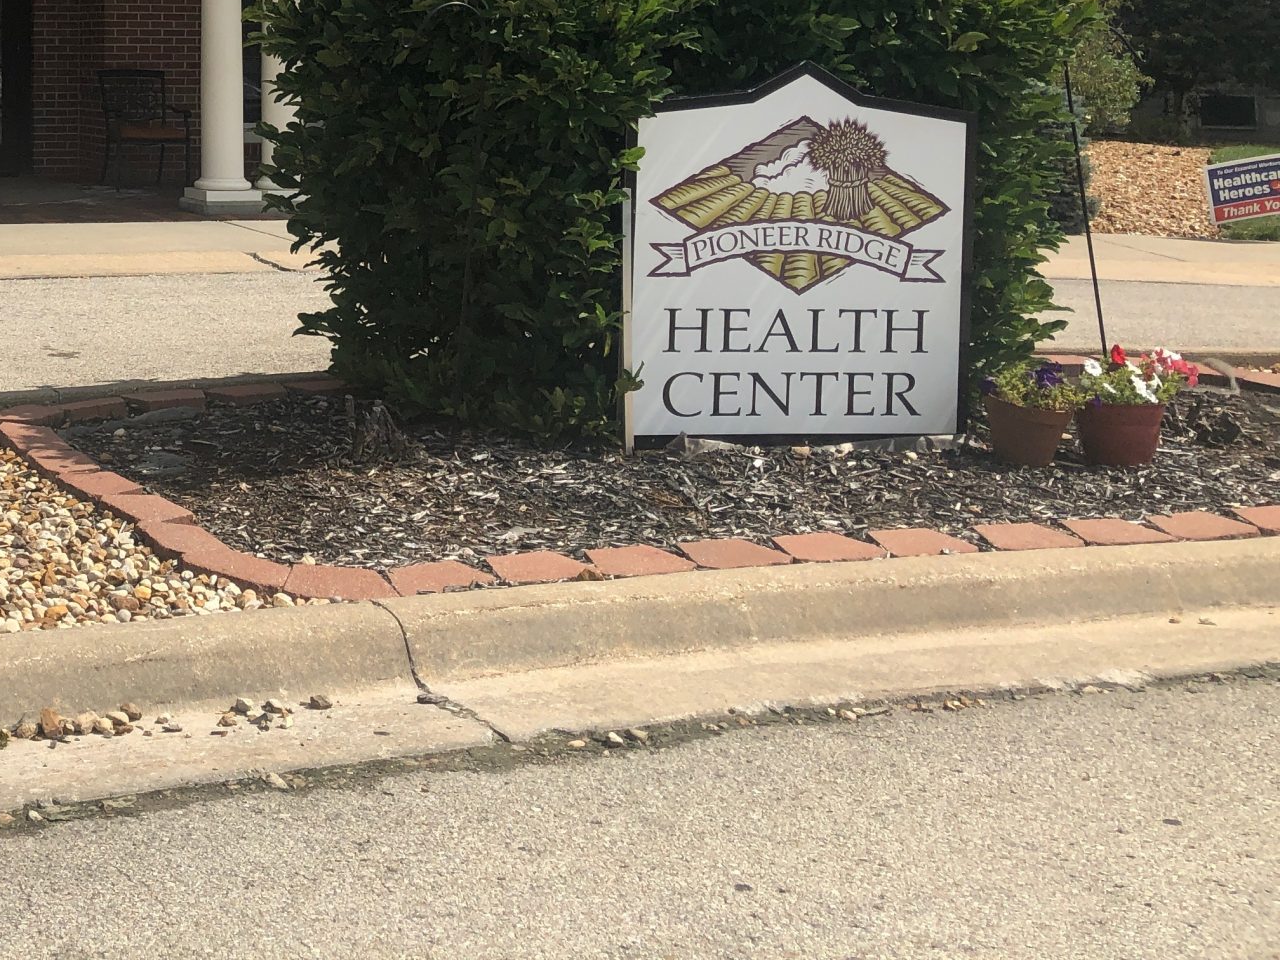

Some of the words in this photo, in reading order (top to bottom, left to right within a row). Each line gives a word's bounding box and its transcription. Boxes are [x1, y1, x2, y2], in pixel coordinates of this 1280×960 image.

[1219, 184, 1271, 201] Heroes
[1223, 203, 1261, 218] Thank
[692, 225, 810, 262] PIONEER
[818, 228, 903, 268] RIDGE
[662, 307, 931, 354] HEALTH
[662, 371, 922, 418] CENTER
